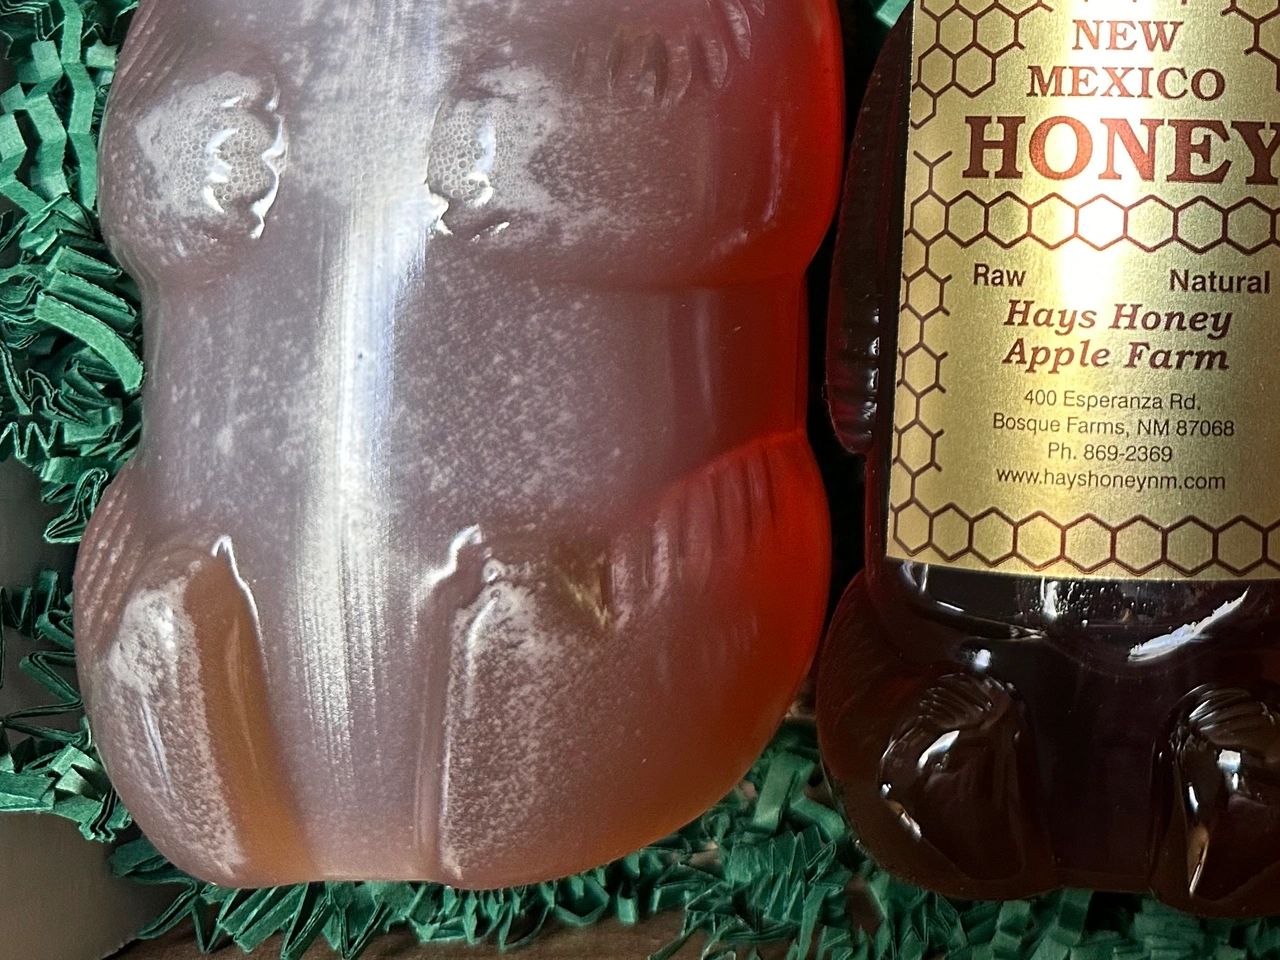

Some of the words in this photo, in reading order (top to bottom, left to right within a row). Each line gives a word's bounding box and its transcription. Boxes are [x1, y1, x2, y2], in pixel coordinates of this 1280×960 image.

[1072, 19, 1183, 52] NEW
[1026, 66, 1225, 101] MEXICO
[973, 263, 1026, 287] Raw
[1169, 269, 1271, 295] Natural
[1003, 299, 1097, 335] Hays
[1109, 304, 1232, 340] Honey
[1001, 338, 1110, 375] Apple
[1124, 342, 1229, 372] Farm
[1024, 390, 1057, 407] 400
[1063, 391, 1164, 413] Esperanza
[1169, 394, 1200, 410] Rd.
[993, 413, 1060, 436] Bosque
[1066, 416, 1130, 438] Farms,
[1137, 419, 1169, 436] NM
[1176, 420, 1234, 437] 87068
[1048, 443, 1077, 460] Ph.
[1083, 444, 1173, 462] 869-2369
[996, 469, 1225, 493] www.hayshoneynm.com
